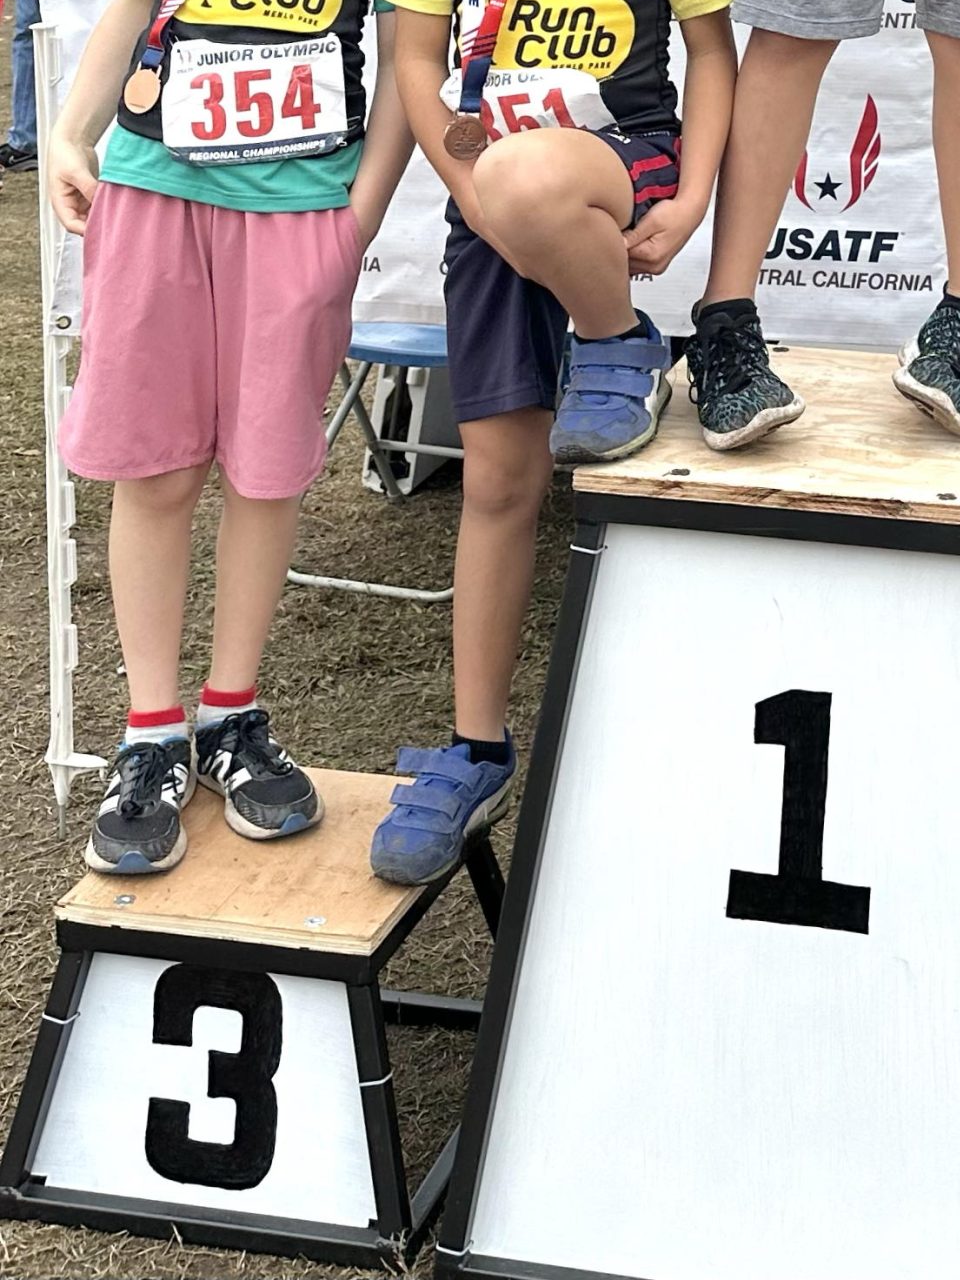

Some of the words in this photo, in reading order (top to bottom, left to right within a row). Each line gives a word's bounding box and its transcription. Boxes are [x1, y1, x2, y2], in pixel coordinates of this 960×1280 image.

[508, 0, 596, 33] Run
[197, 48, 254, 67] JUNIOR
[260, 40, 337, 59] OLYMPIC
[515, 25, 617, 69] Club
[588, 61, 612, 69] PARK
[190, 63, 322, 141] 354
[189, 150, 240, 162] REGIONAL
[243, 139, 326, 158] CHAMPIONSHIPS
[812, 271, 933, 292] CALIFORNIA
[725, 688, 872, 936] 1
[144, 961, 284, 1191] 3
